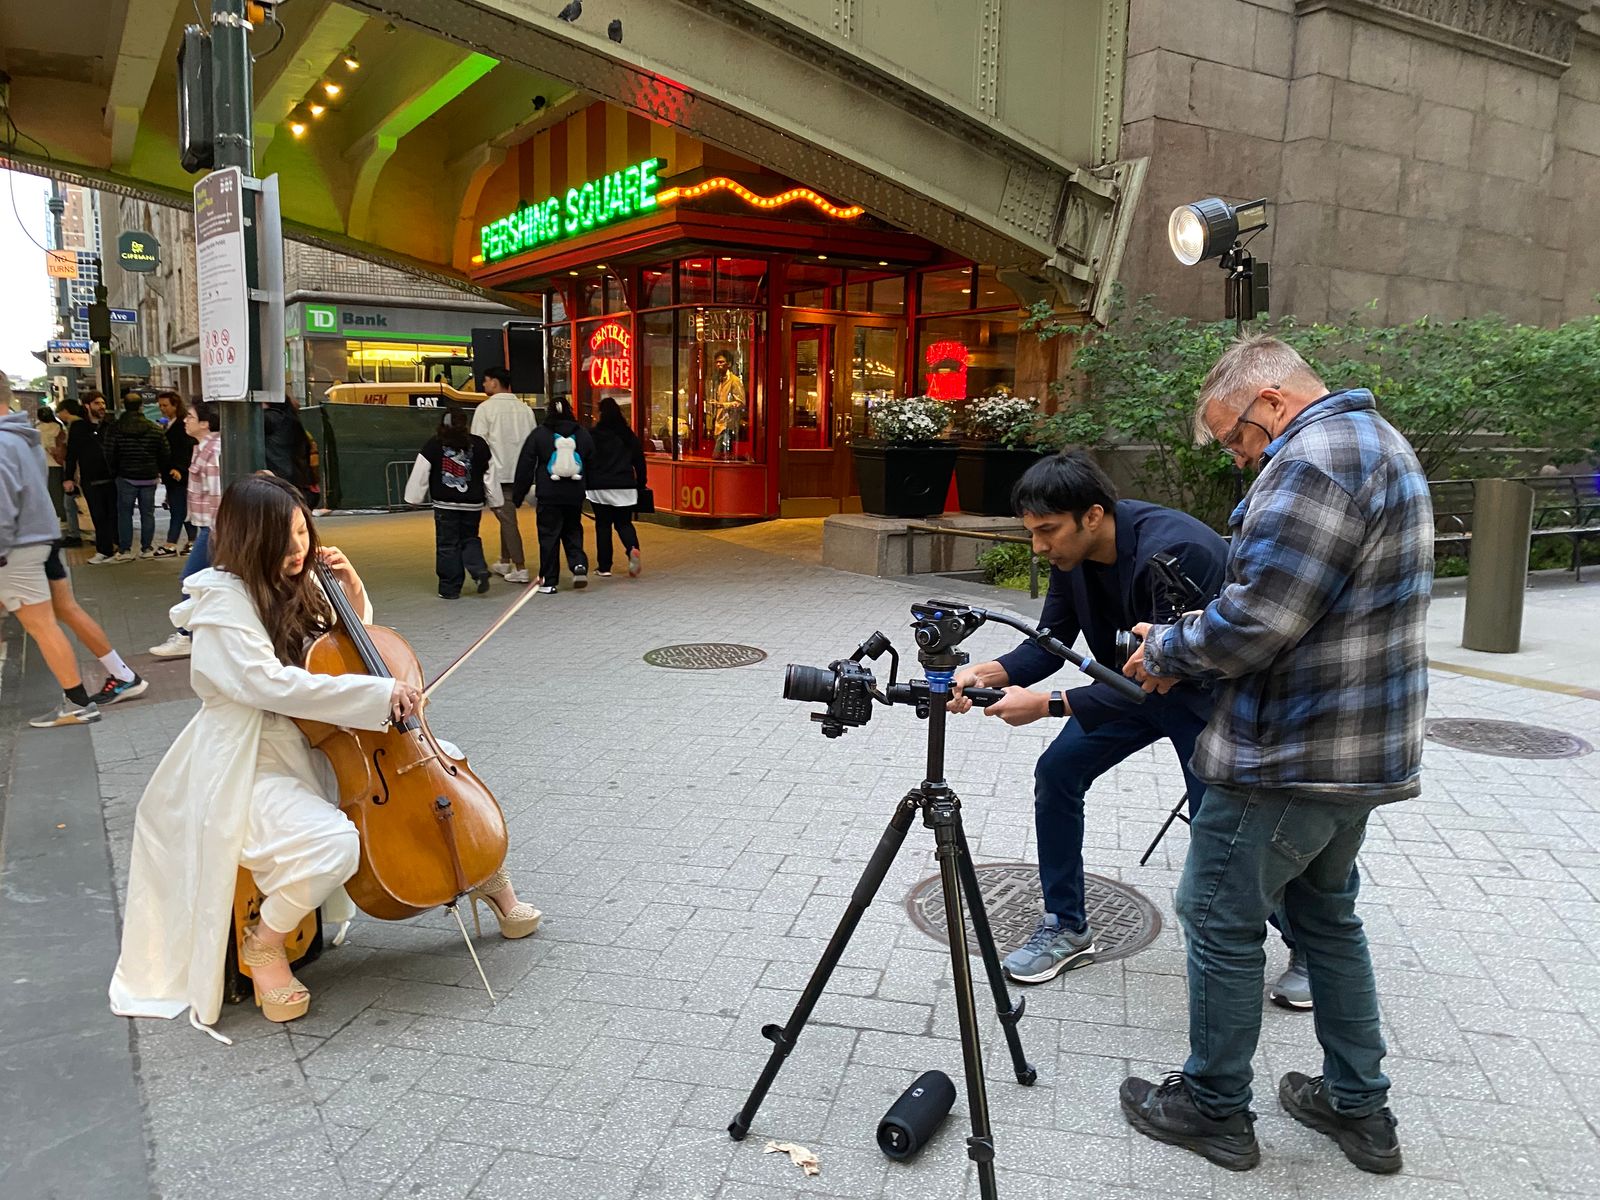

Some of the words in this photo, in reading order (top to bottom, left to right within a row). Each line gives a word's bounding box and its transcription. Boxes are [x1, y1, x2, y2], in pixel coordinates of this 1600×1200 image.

[481, 196, 560, 262] PERSHING
[565, 157, 658, 234] SQUARE
[55, 255, 67, 263] NO
[49, 265, 76, 274] TURNS
[110, 311, 128, 321] Ave
[309, 309, 335, 328] TD
[342, 312, 388, 327] Bank
[591, 324, 631, 350] CENTRAL
[417, 397, 439, 408] CAT
[681, 486, 705, 509] 90
